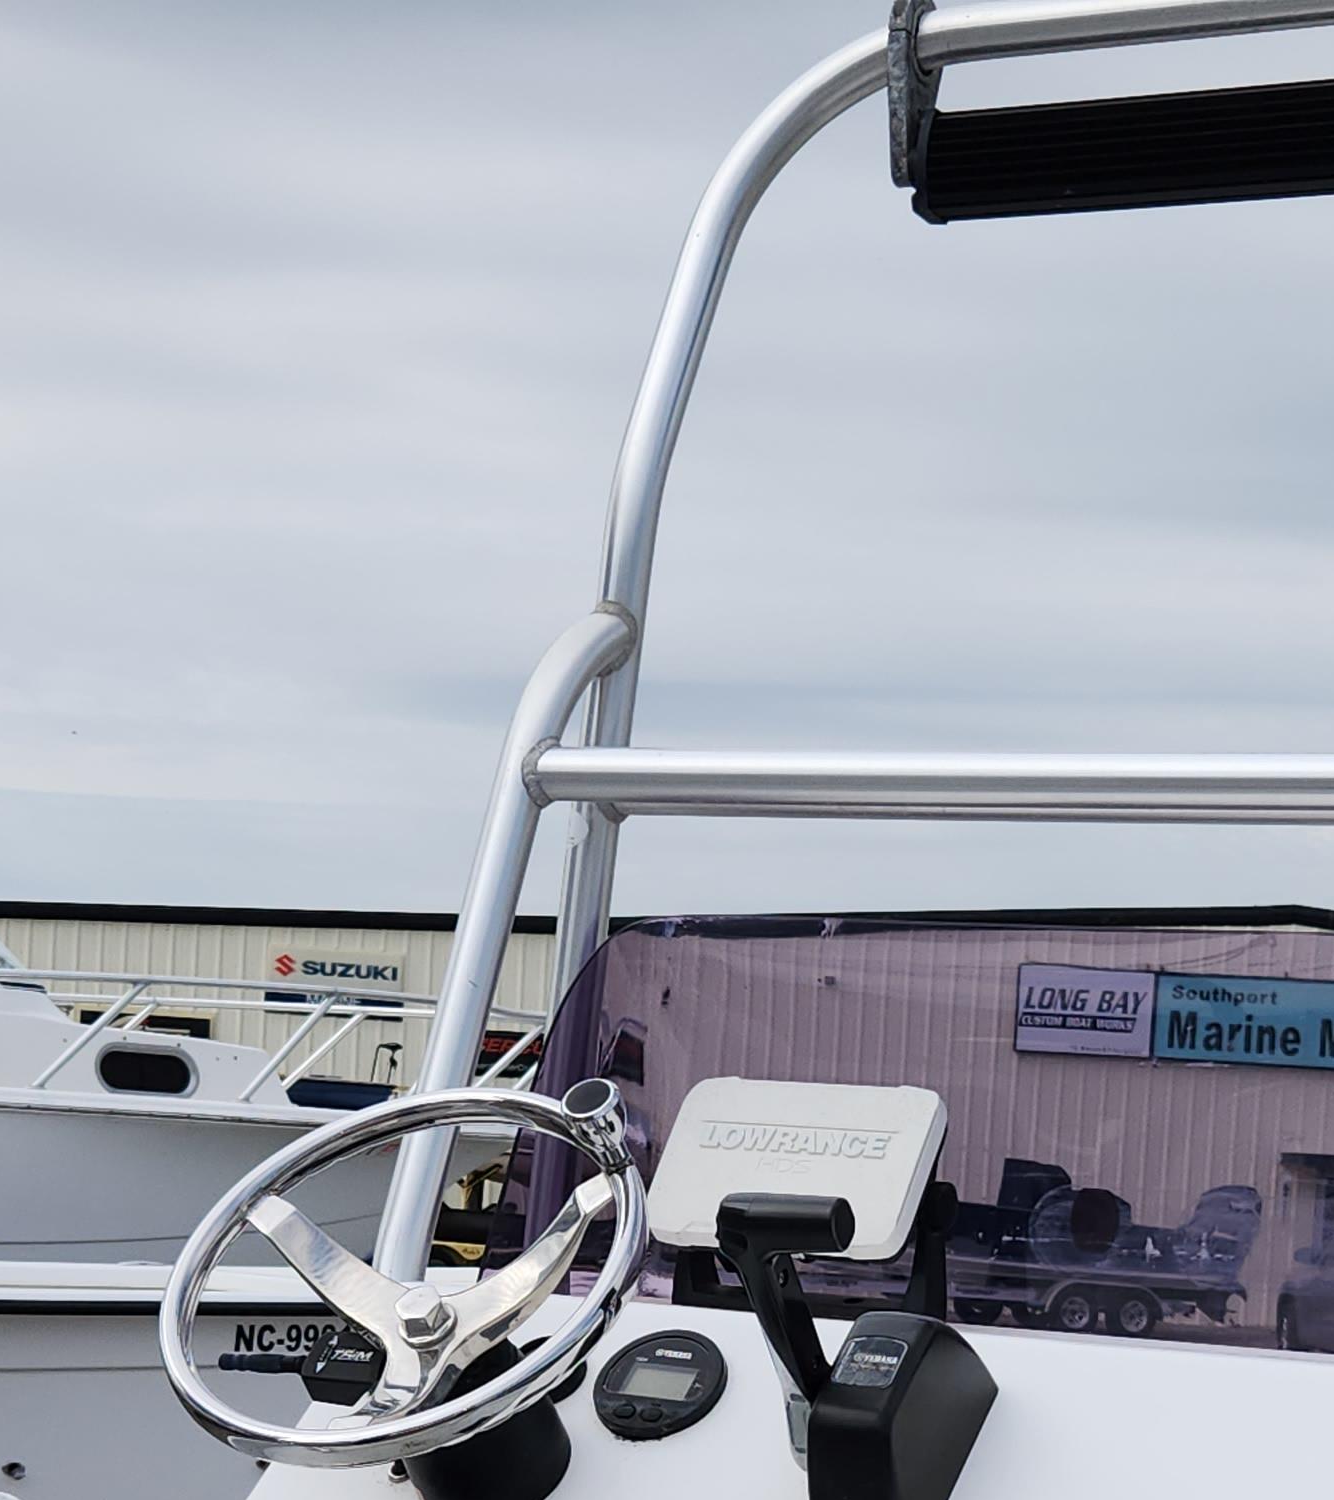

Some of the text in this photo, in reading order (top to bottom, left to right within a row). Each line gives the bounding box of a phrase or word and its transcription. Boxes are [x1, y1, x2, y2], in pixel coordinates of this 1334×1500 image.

[301, 960, 398, 982] SUZUKI
[1023, 986, 1148, 1015] LONG BAY
[1172, 985, 1278, 1007] Southport
[1167, 1010, 1302, 1056] Marine
[698, 1124, 892, 1160] LOWRANCE
